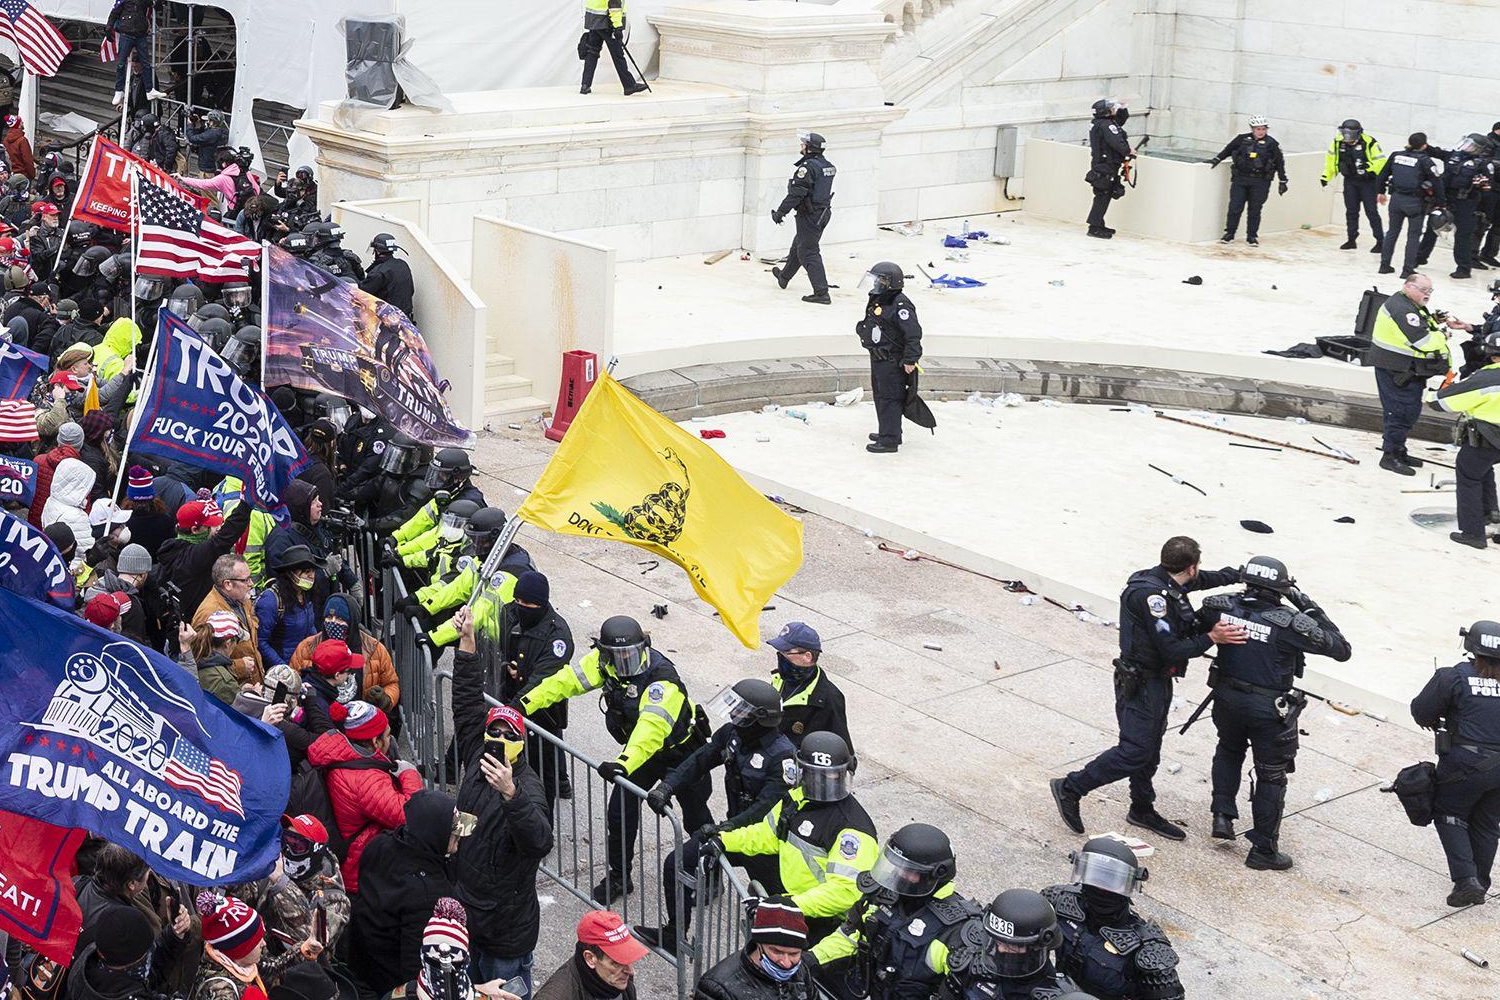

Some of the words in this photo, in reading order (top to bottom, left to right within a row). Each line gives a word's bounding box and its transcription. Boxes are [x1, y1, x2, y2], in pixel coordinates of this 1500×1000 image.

[90, 200, 128, 219] KEEPING
[311, 347, 359, 365] TRUMP
[172, 327, 299, 460] TRUMP
[397, 383, 438, 425] TRUMP
[150, 417, 201, 446] FUCK
[201, 431, 247, 459] YOUR
[213, 401, 272, 466] 2020
[1246, 562, 1279, 581] MPDC
[1481, 633, 1500, 649] MP
[99, 714, 168, 771] 2020
[812, 751, 832, 767] 136
[8, 752, 121, 812] TRUMP
[124, 798, 238, 880] TRAIN
[101, 760, 131, 789] ALL
[131, 778, 209, 830] ABOARD
[211, 820, 240, 843] THE
[989, 913, 1015, 937] 4836
